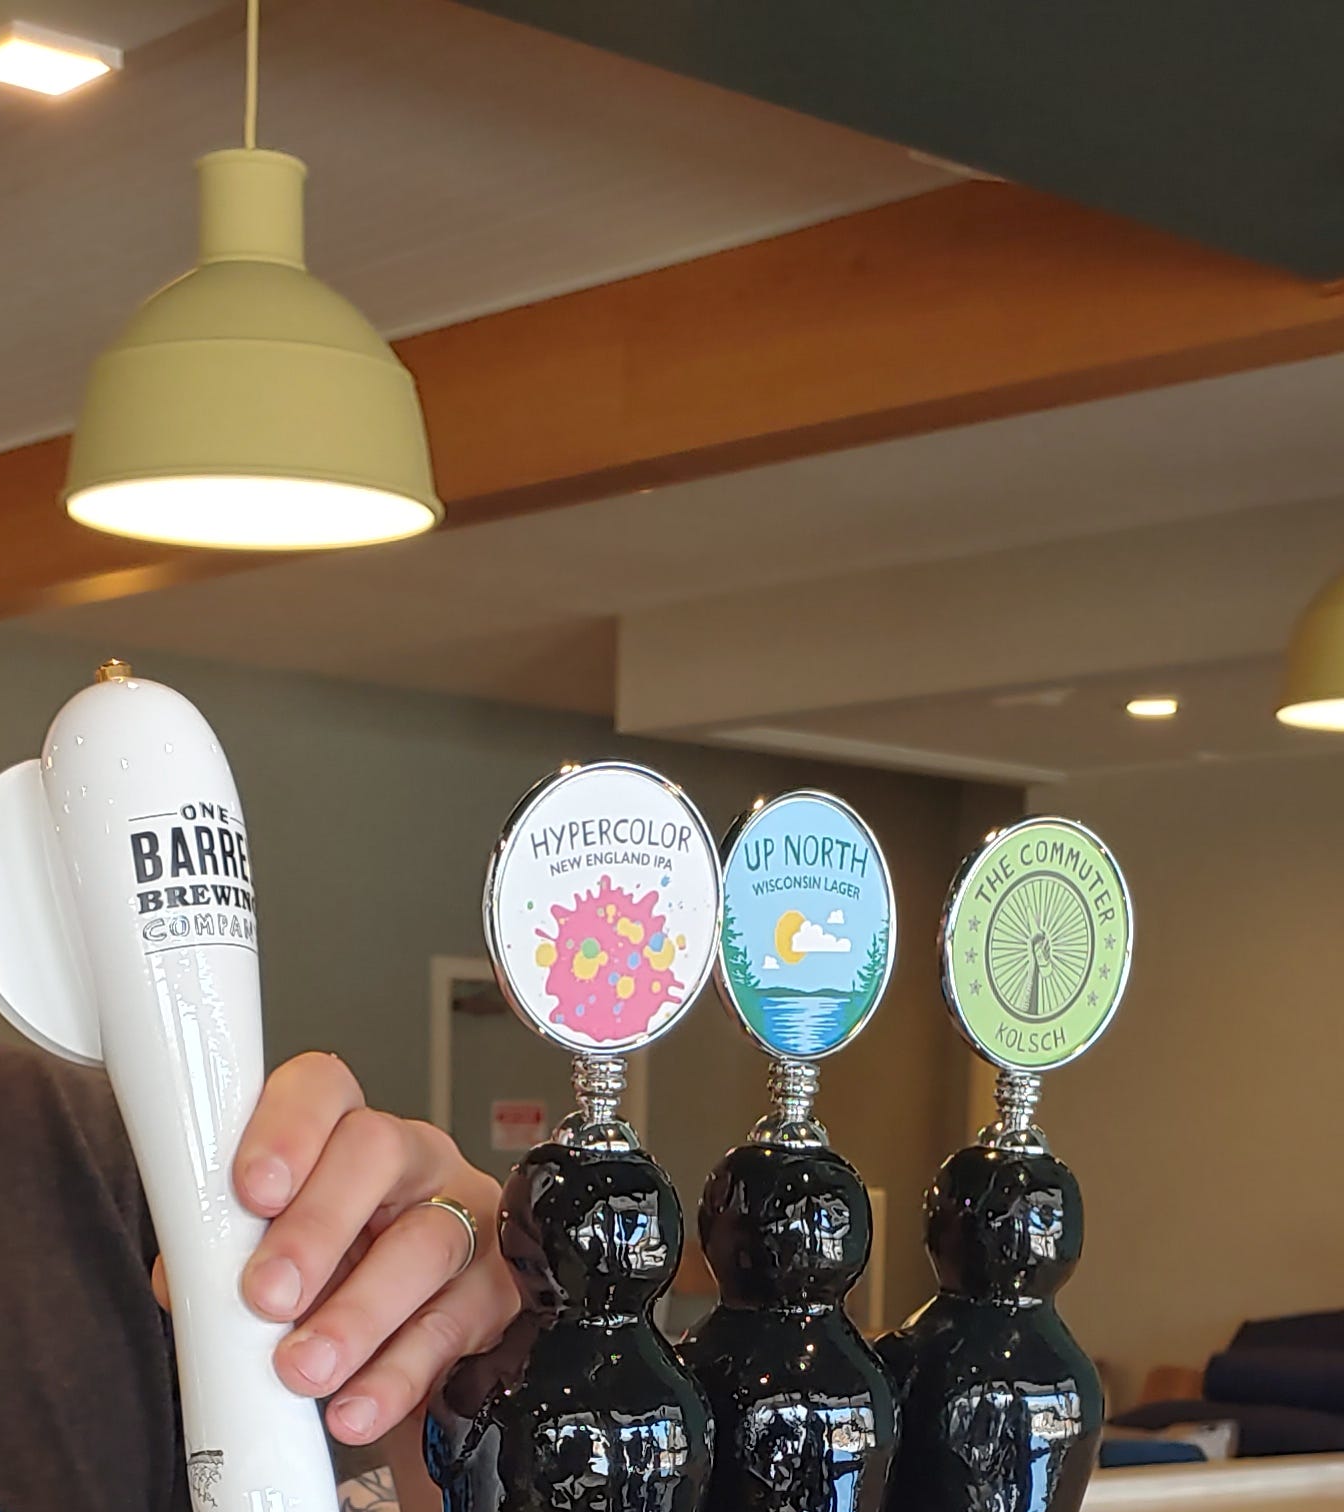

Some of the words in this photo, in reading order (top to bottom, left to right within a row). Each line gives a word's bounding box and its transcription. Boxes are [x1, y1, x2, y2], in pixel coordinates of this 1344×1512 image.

[180, 801, 229, 824] ONE
[530, 818, 692, 859] HYPERCOLOR
[130, 825, 255, 888] BARRE
[549, 854, 582, 876] NEW
[586, 852, 651, 867] ENGLAND
[654, 855, 673, 871] IPA
[744, 838, 775, 872] UP
[784, 835, 869, 878] NORTH
[752, 875, 822, 896] WISCONSIN
[824, 878, 861, 900] LAGER
[974, 854, 1015, 905] THE
[1020, 840, 1115, 926] COMMUTER
[142, 913, 256, 943] COMPAN
[995, 1022, 1066, 1053] KOLSCH
